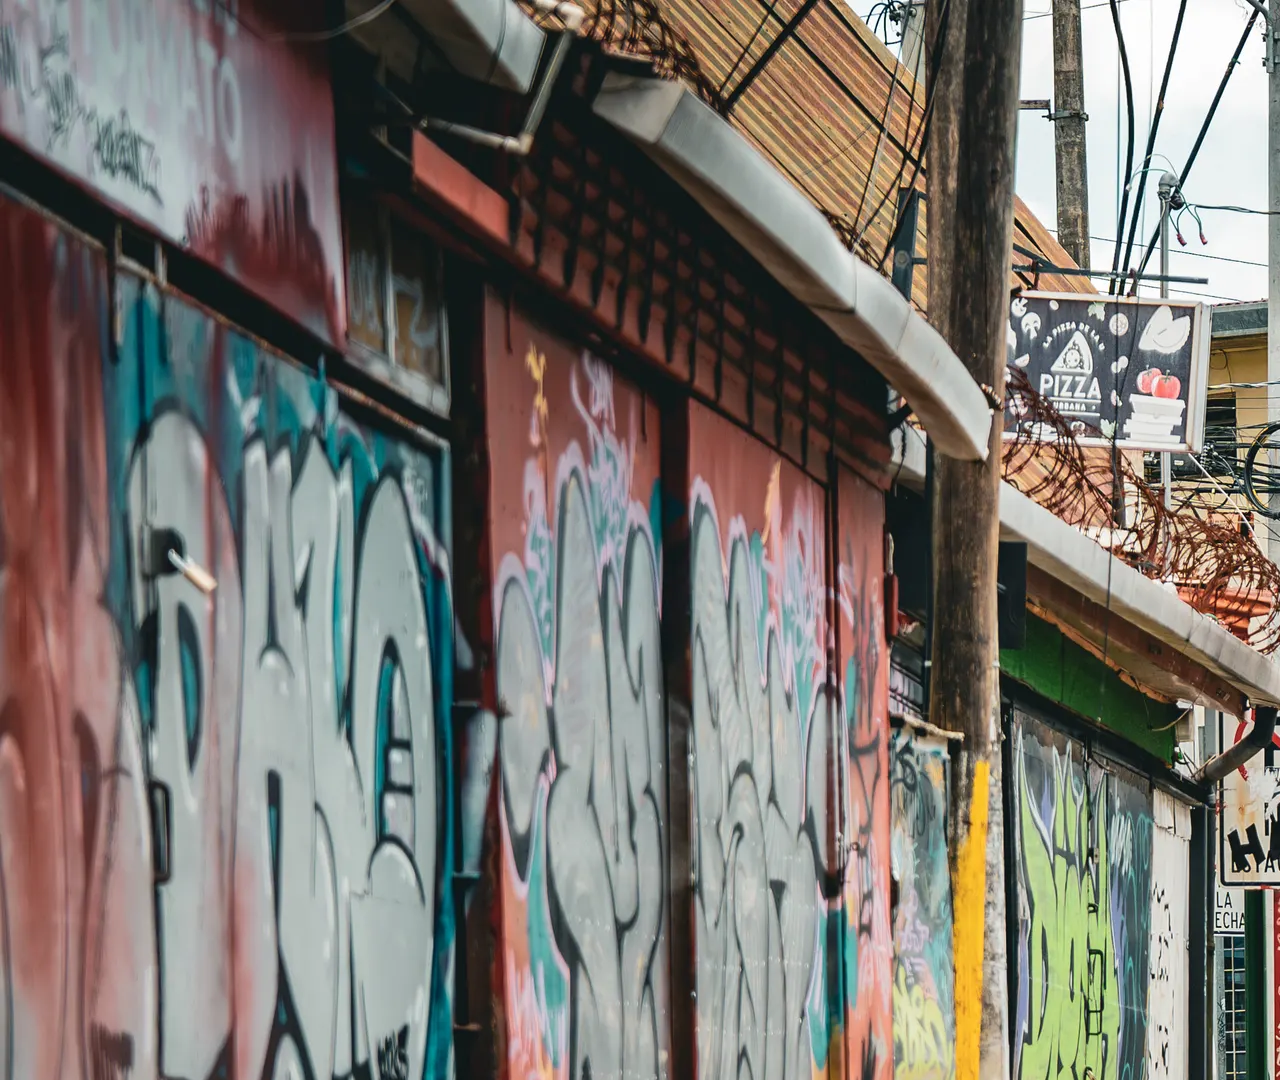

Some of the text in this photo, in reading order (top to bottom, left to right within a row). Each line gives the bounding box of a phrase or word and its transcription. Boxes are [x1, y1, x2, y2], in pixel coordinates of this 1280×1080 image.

[1052, 321, 1077, 336] PIZZA
[1040, 373, 1102, 399] PIZZA
[1216, 892, 1233, 909] LA
